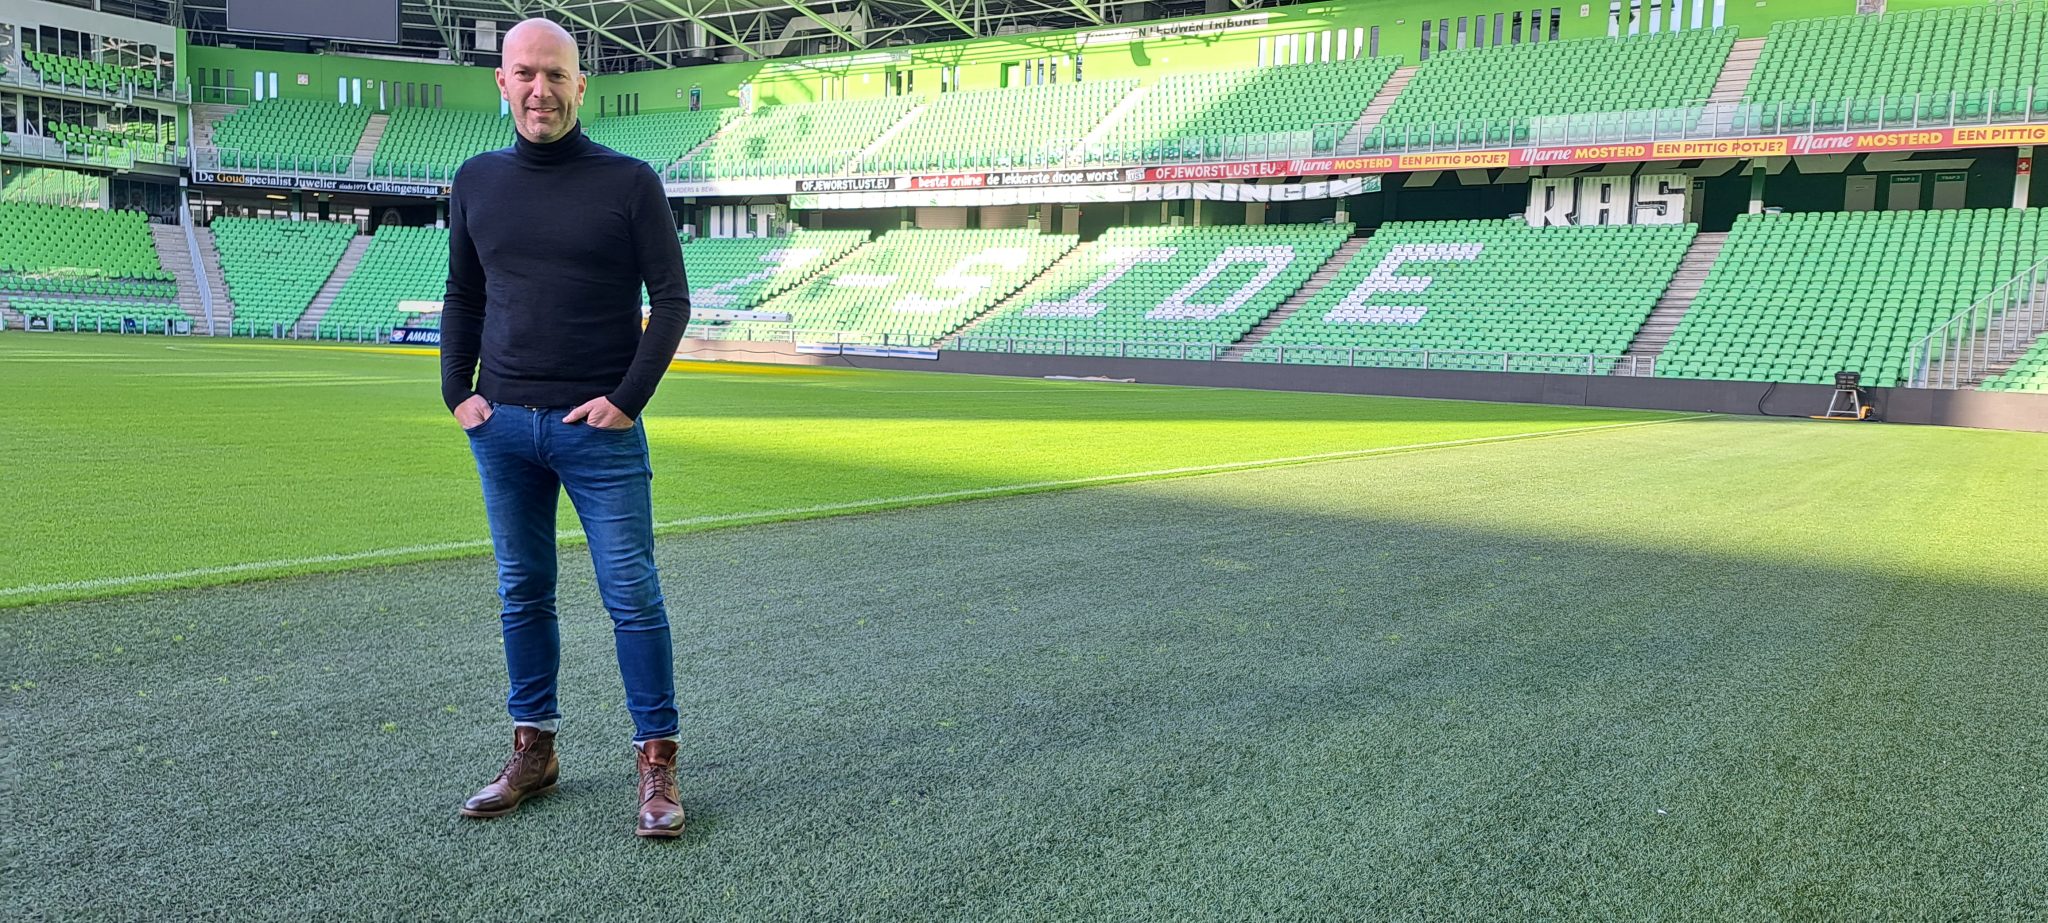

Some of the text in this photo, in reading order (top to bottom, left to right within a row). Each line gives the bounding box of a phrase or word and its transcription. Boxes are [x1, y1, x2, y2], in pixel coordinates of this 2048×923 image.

[1793, 132, 1943, 153] Marne MOSTERD
[1957, 128, 2045, 140] EEN PITTIG
[1520, 145, 1646, 165] Marne MOSTERD
[1656, 141, 1784, 153] EEN PITTIG POTJE?
[1290, 158, 1392, 173] Marne MOSTERD
[1402, 153, 1506, 165] EEN PITTIG POTJE?
[918, 169, 1118, 188] bestel online de lekkerste droge worst
[1156, 162, 1276, 179] OFJEWORSTLUST.EU
[200, 172, 214, 182] De
[217, 172, 292, 186] Goudspecialist
[294, 176, 337, 189] Juwelier
[367, 182, 438, 195] Gelkingestraat
[802, 178, 889, 191] OFJEWORSTLUST.EU
[1526, 174, 1685, 227] RAS
[710, 205, 776, 239] ULT
[406, 330, 440, 343] AMASUS
